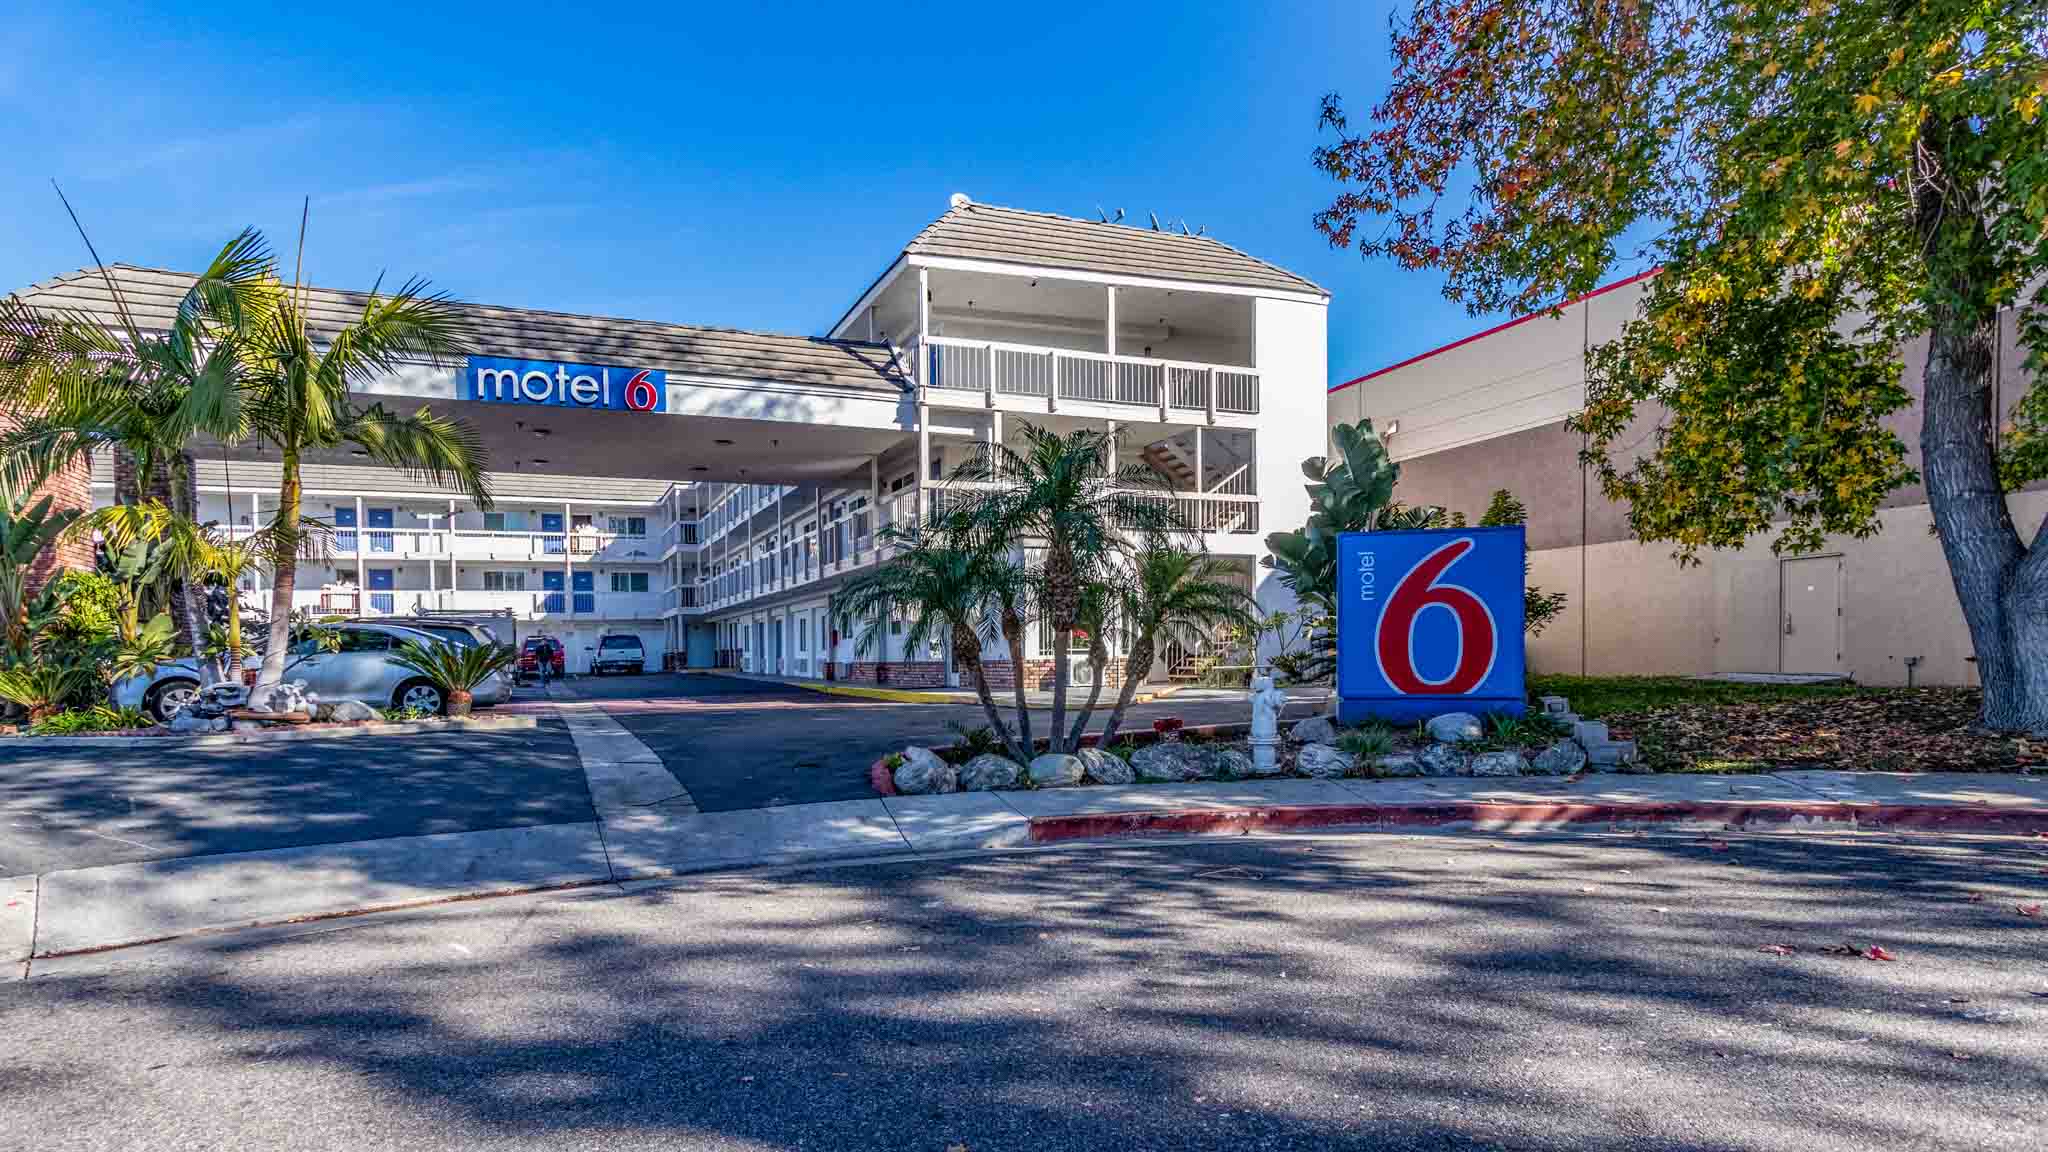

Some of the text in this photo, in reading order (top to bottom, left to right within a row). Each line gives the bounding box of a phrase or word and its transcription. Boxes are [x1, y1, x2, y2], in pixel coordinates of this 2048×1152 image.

[477, 365, 658, 411] motel 6
[1358, 551, 1376, 601] motel
[1374, 537, 1498, 695] 6
